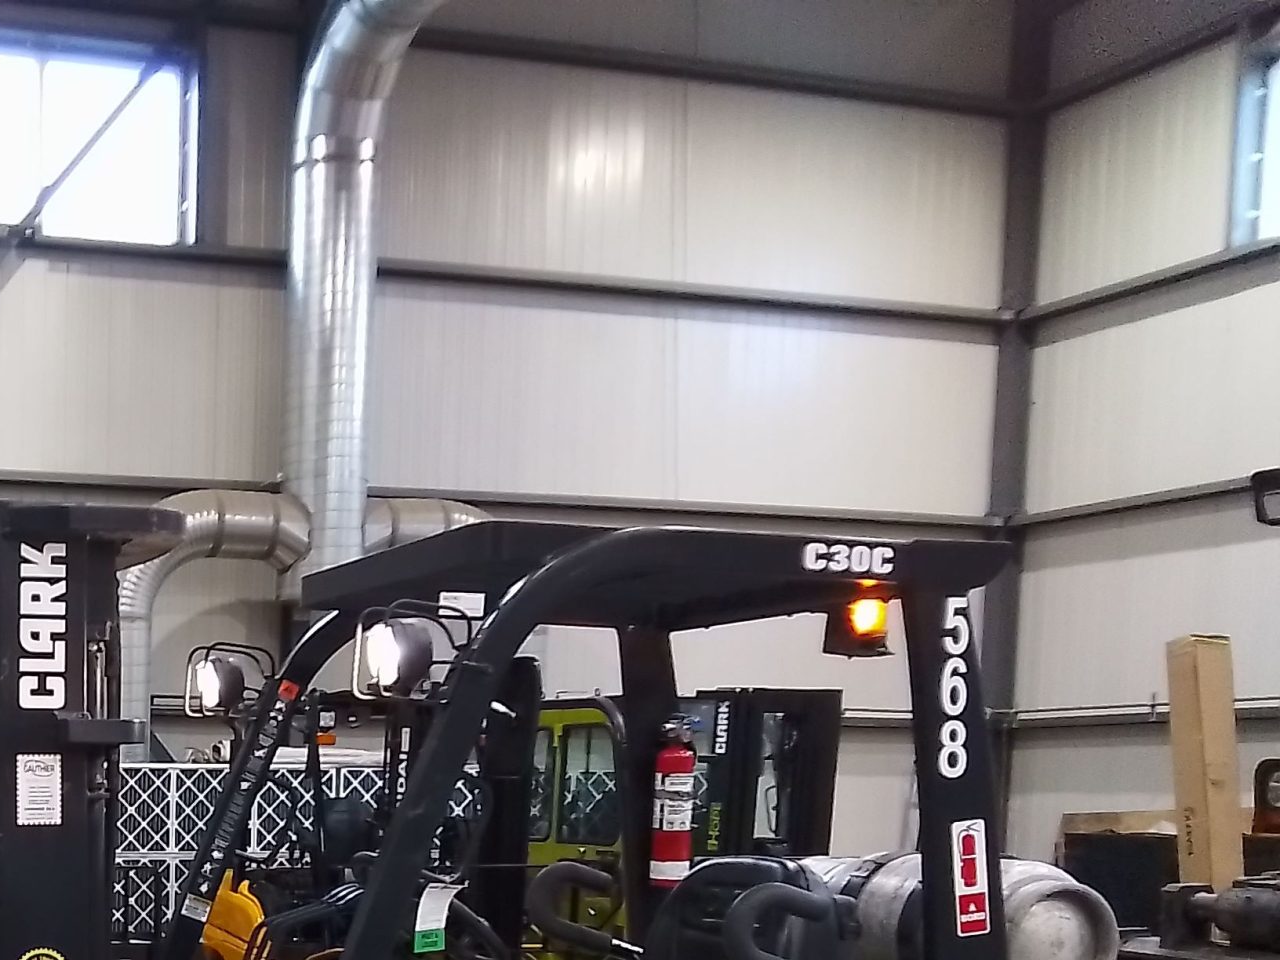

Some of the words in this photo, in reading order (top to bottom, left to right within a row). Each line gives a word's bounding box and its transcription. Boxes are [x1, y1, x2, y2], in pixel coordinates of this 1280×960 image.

[19, 542, 67, 710] CLARK
[802, 541, 896, 575] C30C
[937, 596, 970, 780] 568
